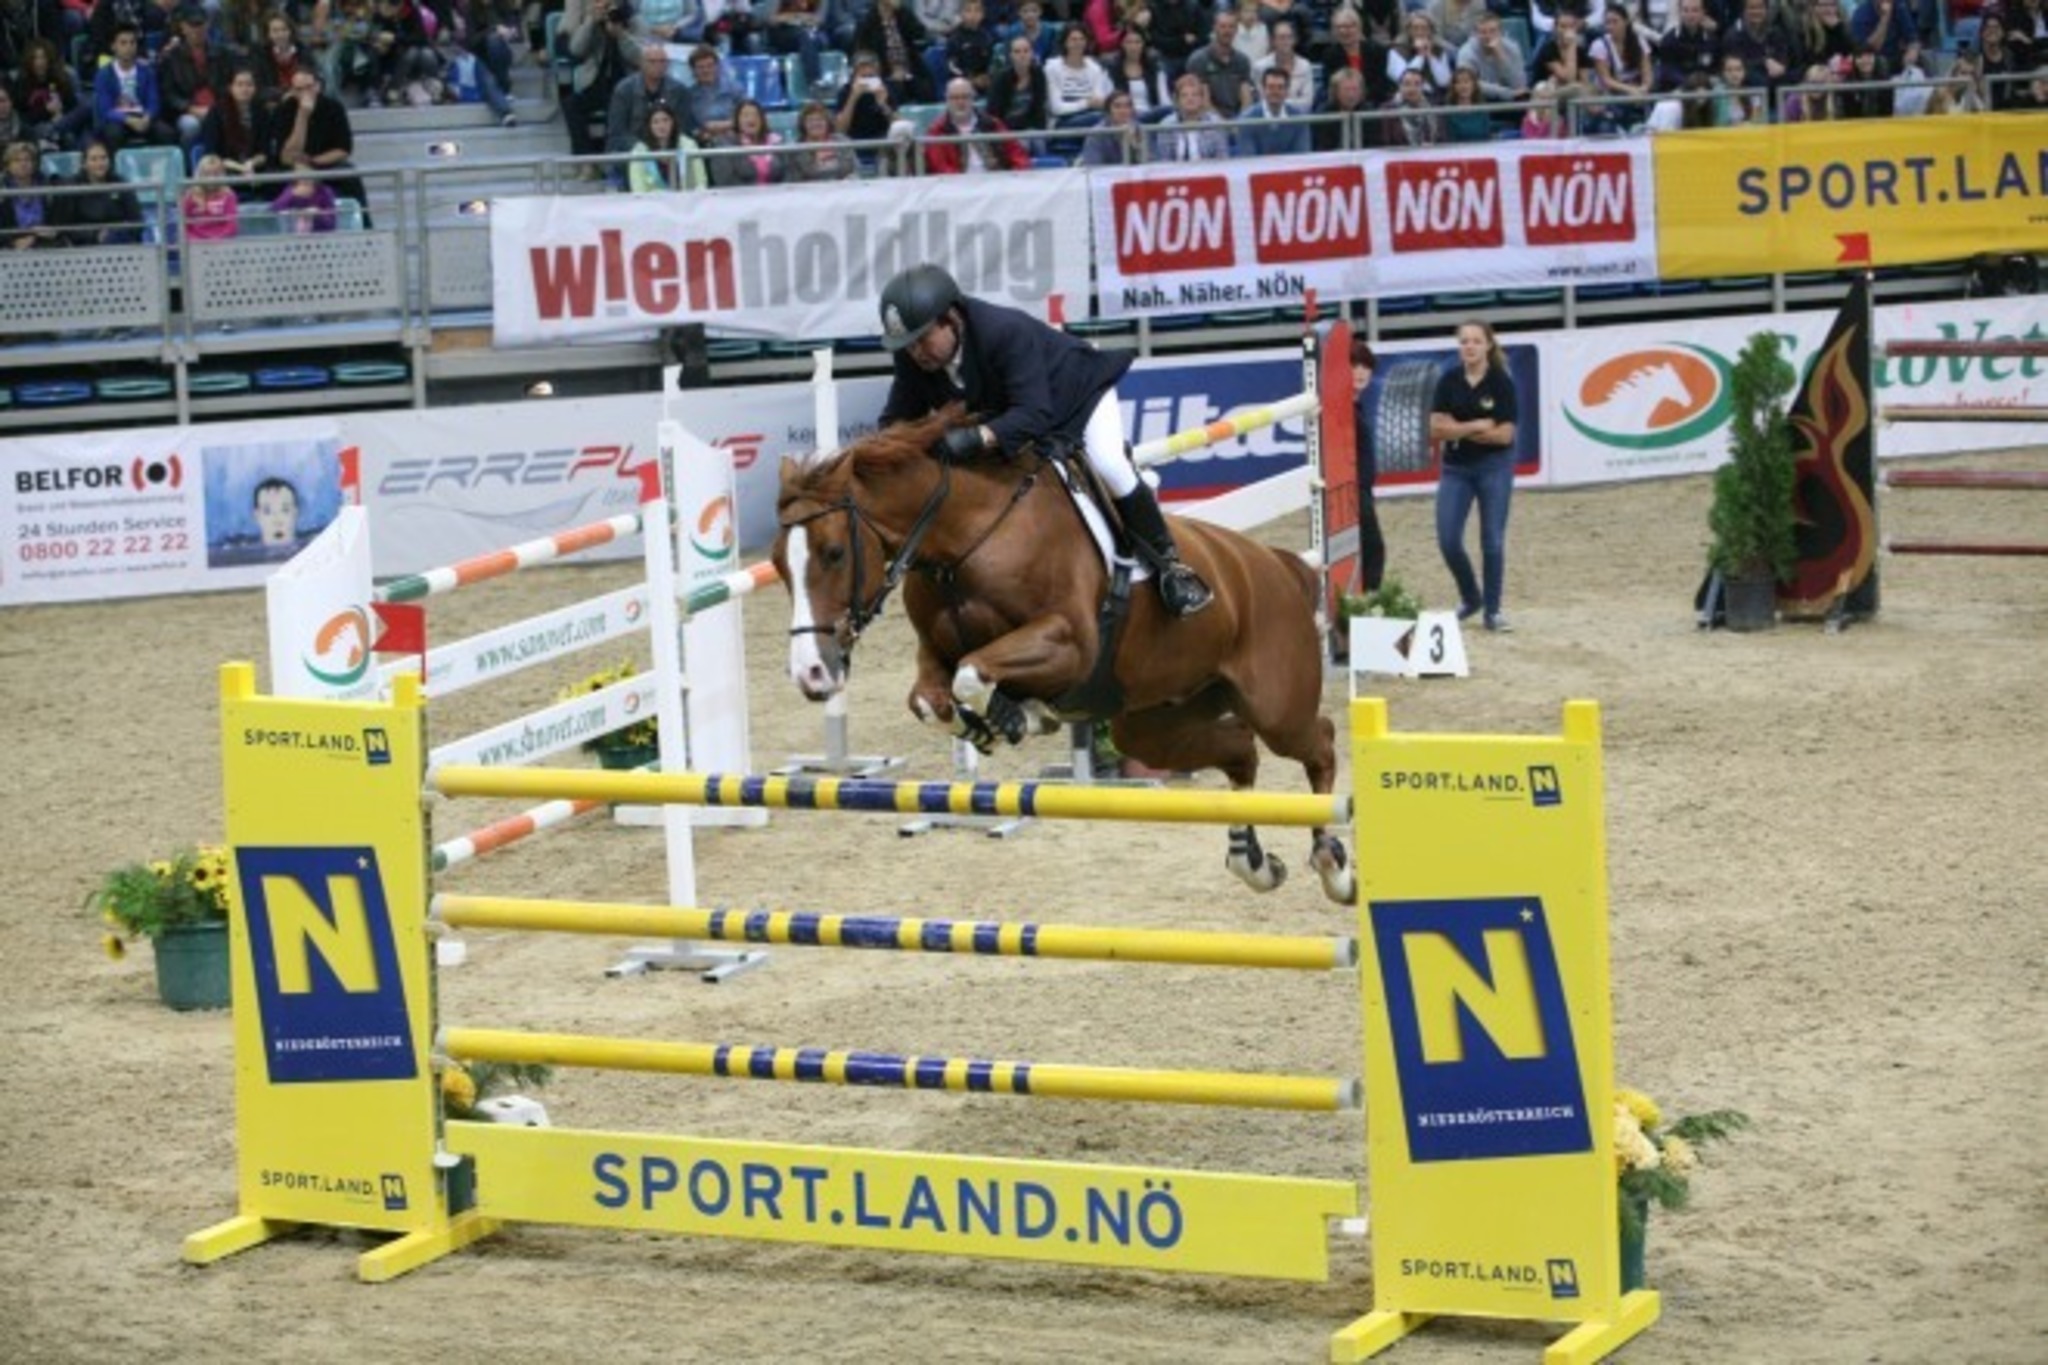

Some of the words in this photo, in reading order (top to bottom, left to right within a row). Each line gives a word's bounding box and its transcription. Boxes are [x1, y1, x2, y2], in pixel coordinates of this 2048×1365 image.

[1121, 186, 1225, 255] NÖN
[1260, 176, 1362, 246] NÖN
[1395, 167, 1493, 235] NÖN
[1527, 160, 1629, 229] NÖN
[1123, 288, 1174, 309] Nah.
[1179, 280, 1251, 305] Näher.
[1256, 272, 1306, 297] NÖN
[16, 465, 123, 493] BELFOR
[377, 433, 764, 496] ERREPLS
[18, 523, 41, 539] 24
[46, 519, 119, 537] Stunden
[123, 515, 187, 532] Service
[20, 541, 79, 562] 0800
[87, 538, 116, 557] 22
[124, 535, 152, 553] 22
[161, 532, 190, 550] 22
[1430, 623, 1444, 664] 3
[244, 728, 361, 752] SPORT.LAND.
[1380, 771, 1525, 792] SPORT.LAND.
[261, 874, 380, 994] N
[1402, 929, 1546, 1064] N
[1417, 1105, 1575, 1127] NIEDERÖSTERREICH
[261, 1170, 378, 1195] SPORT.LAND.
[592, 1152, 1183, 1249] SPORT.LAND.NÖ
[1401, 1258, 1542, 1284] SPORT.LAND.
